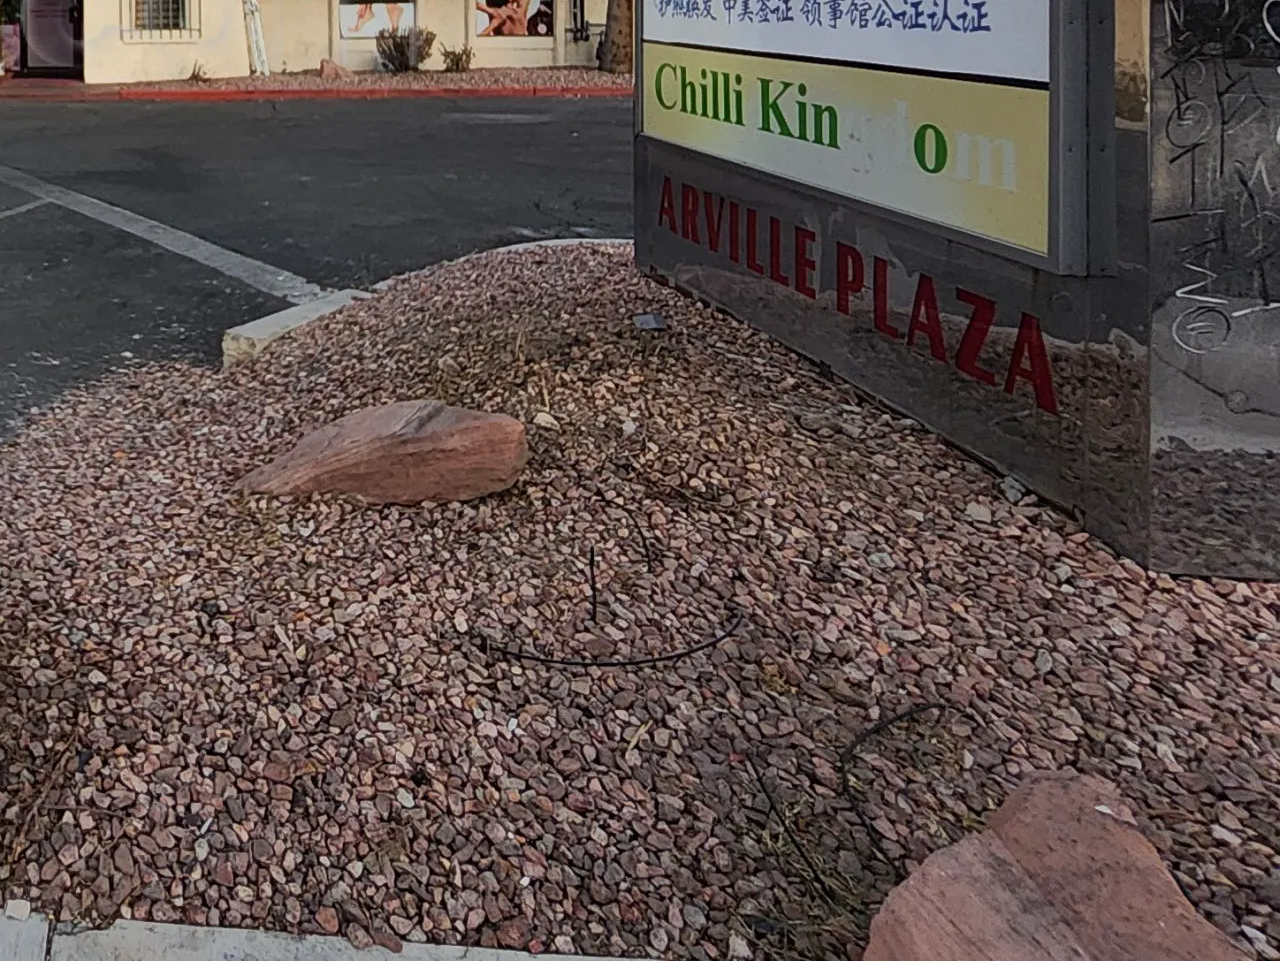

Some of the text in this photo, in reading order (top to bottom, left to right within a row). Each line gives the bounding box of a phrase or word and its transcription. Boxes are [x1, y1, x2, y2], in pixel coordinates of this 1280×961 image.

[654, 62, 745, 127] Chilli
[658, 175, 817, 300] ARVILLE
[836, 240, 1058, 416] PLAZA
